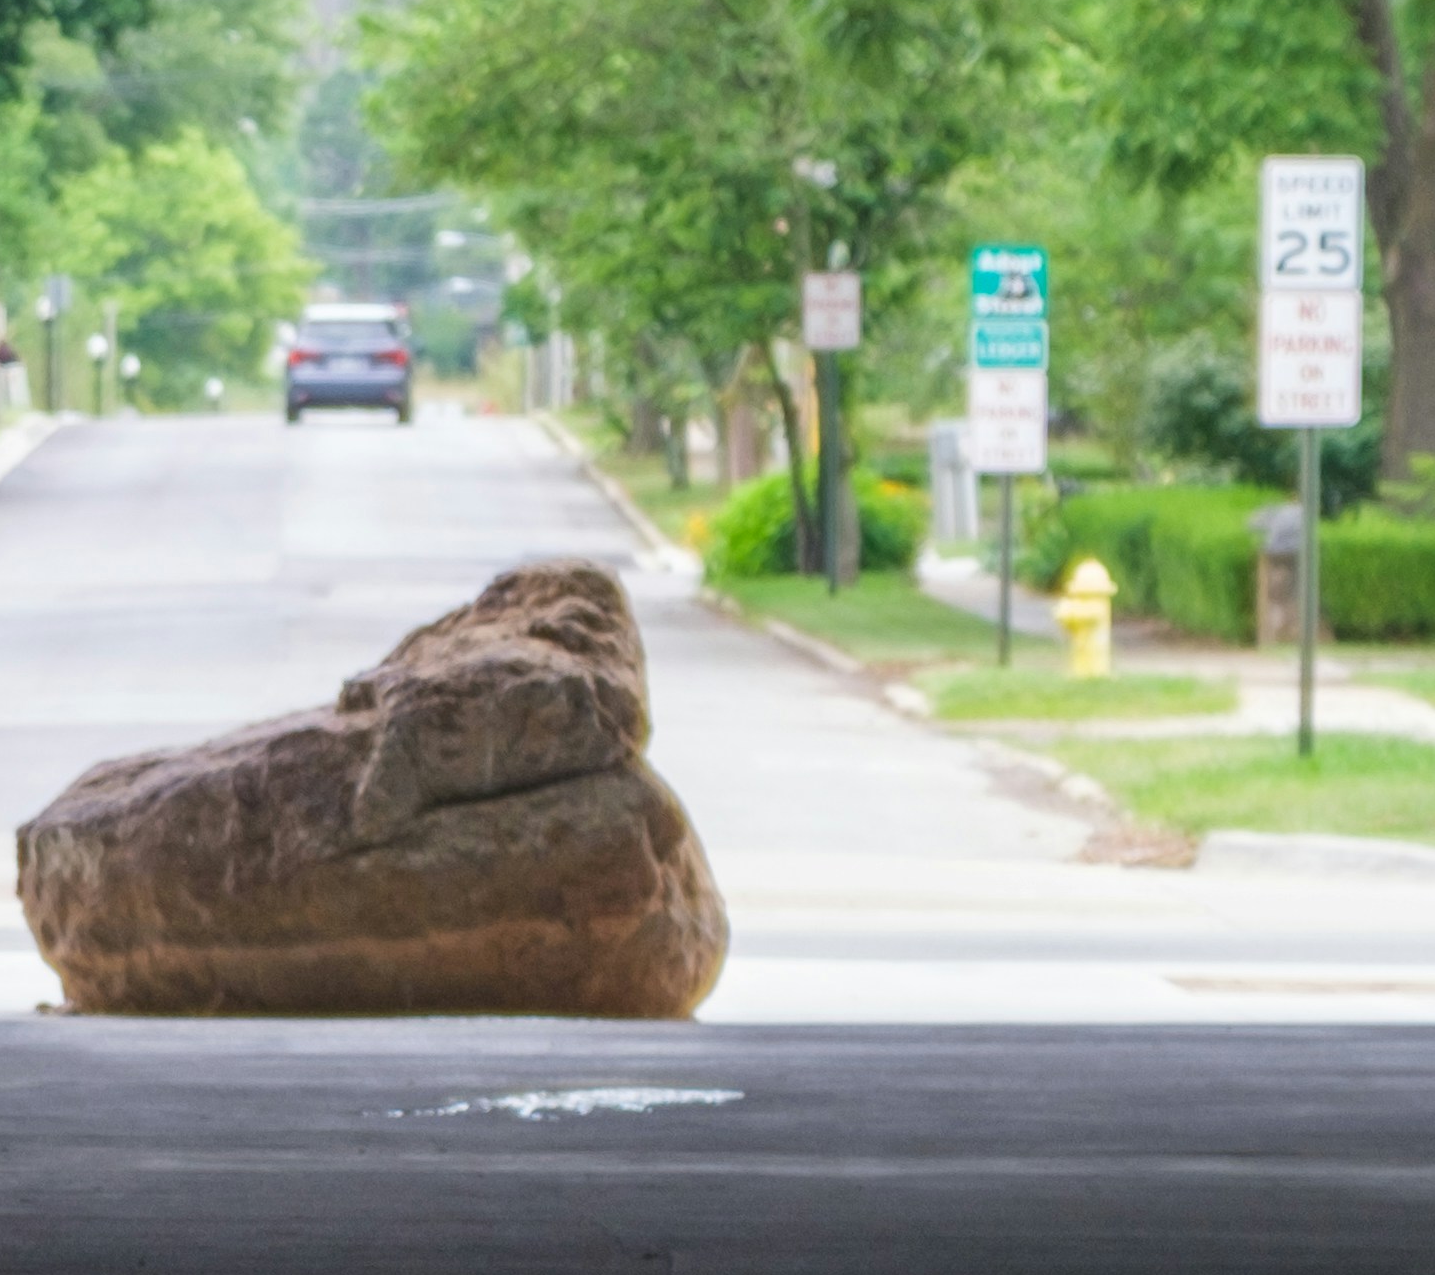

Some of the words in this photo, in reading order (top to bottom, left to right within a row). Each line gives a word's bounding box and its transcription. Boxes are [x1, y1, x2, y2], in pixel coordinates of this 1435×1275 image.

[1276, 174, 1355, 195] SPEED
[1283, 203, 1341, 223] LIMIT
[1276, 229, 1352, 277] 25
[1297, 300, 1326, 325] NO
[1269, 332, 1354, 357] PARKING
[1277, 390, 1346, 413] STREET
